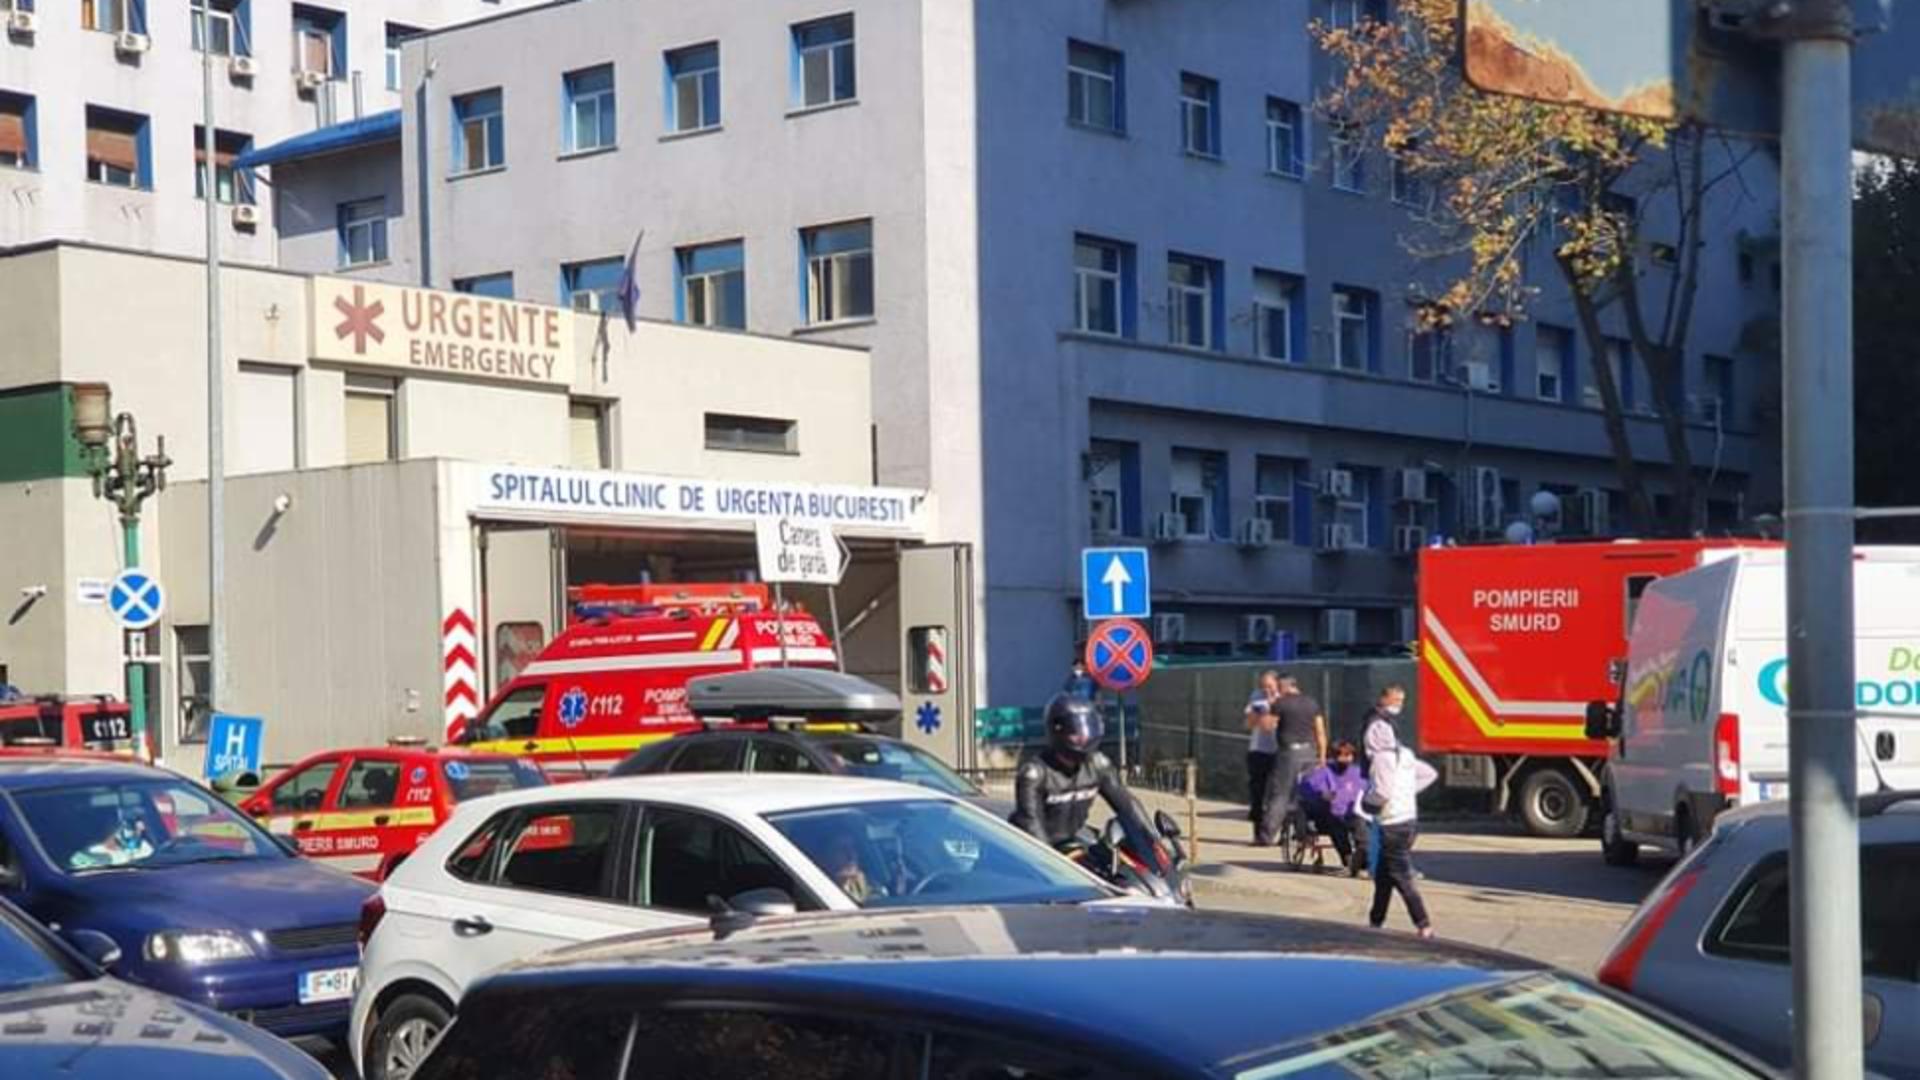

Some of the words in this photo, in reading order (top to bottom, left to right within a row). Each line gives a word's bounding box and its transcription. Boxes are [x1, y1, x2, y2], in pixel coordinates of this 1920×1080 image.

[401, 289, 561, 349] URGENTE
[409, 339, 556, 379] EMERGENCY
[491, 472, 596, 506] SPITALUL
[599, 480, 667, 510] CLINIC
[679, 485, 704, 512] DE
[716, 487, 806, 517] URGENTA
[808, 493, 904, 521] BUCURESTI
[777, 547, 797, 573] de
[1473, 588, 1579, 608] POMPIERII
[1489, 612, 1561, 632] SMURD
[1856, 681, 1920, 706] DO
[225, 723, 248, 756] H
